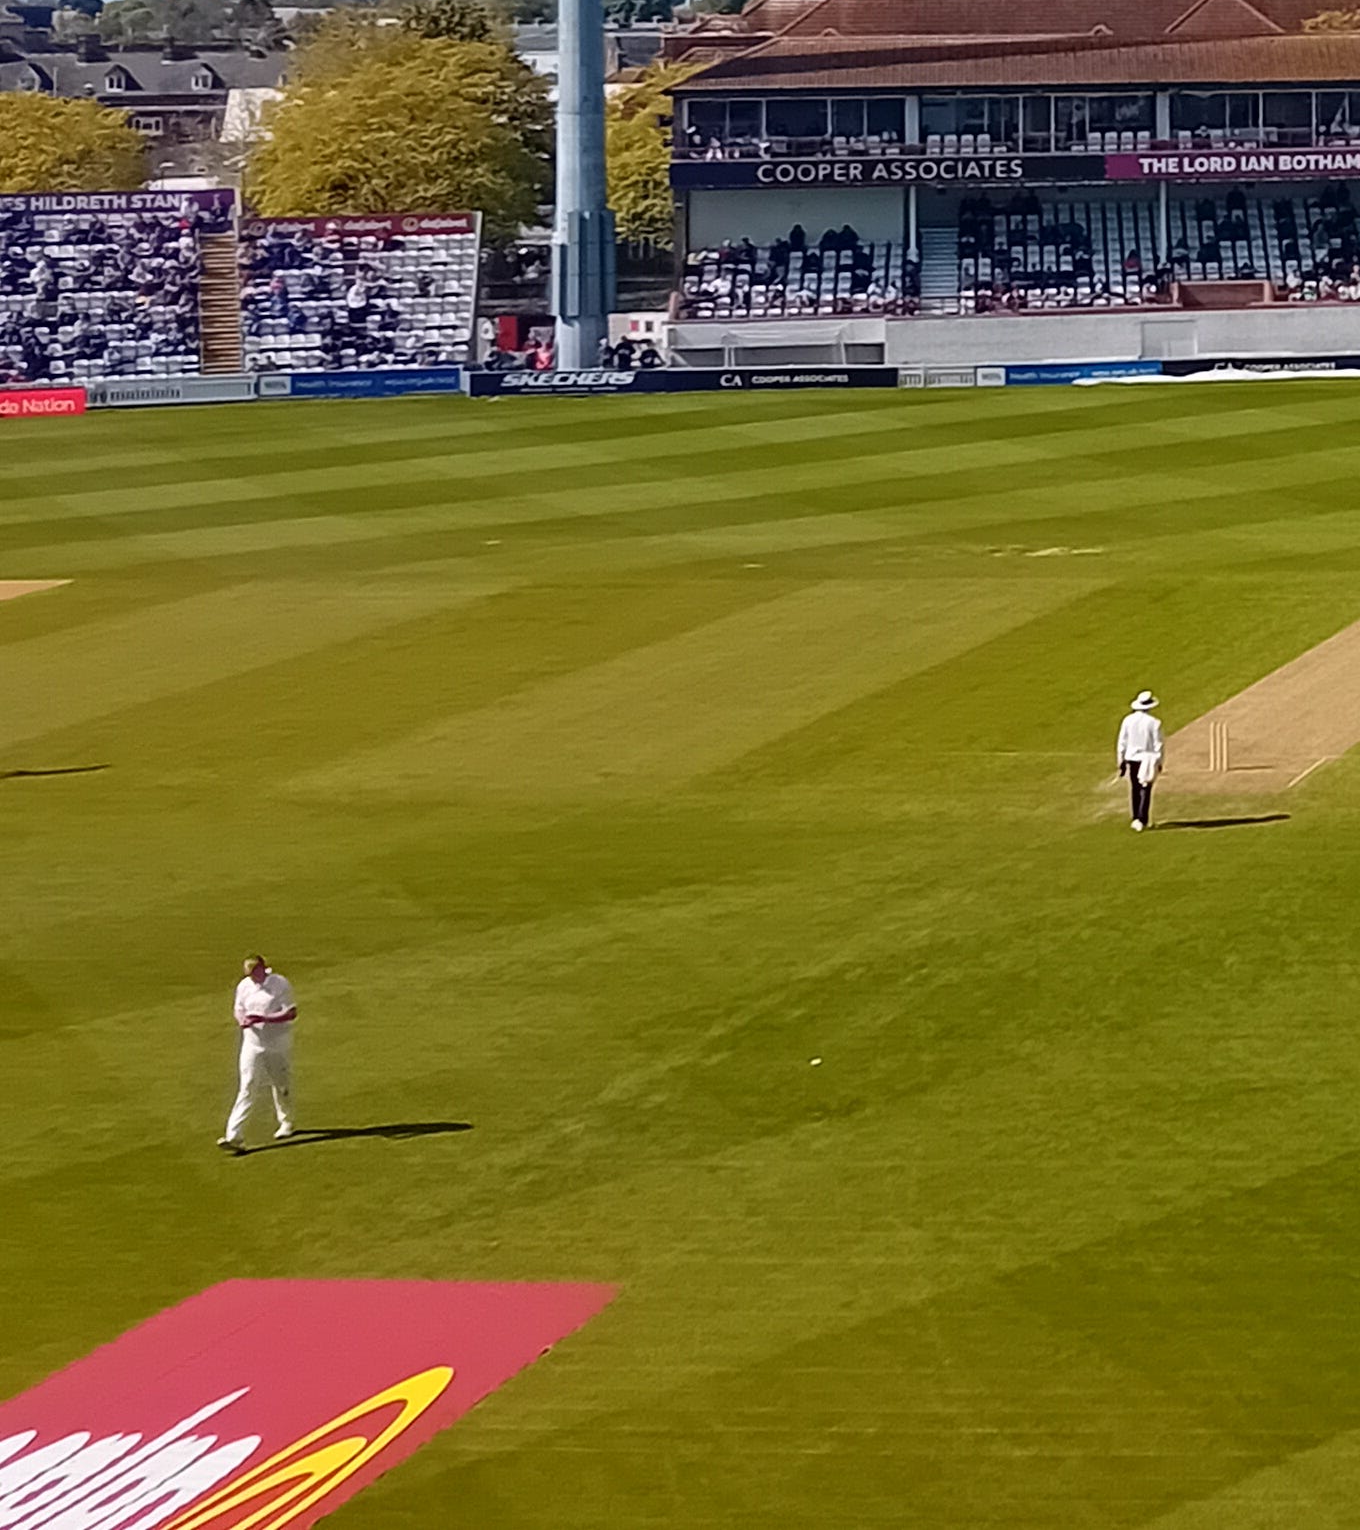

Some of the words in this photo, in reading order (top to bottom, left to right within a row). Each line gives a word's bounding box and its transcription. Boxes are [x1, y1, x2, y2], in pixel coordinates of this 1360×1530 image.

[757, 164, 863, 182] COOPER
[872, 160, 1023, 180] ASSOCIATES
[1139, 157, 1179, 173] THE
[1182, 156, 1236, 172] LORD
[1240, 155, 1274, 171] IAN
[1278, 153, 1360, 170] BOTHAM
[30, 194, 127, 211] HILDRETH
[501, 370, 637, 387] SKECHERS
[720, 374, 742, 387] CA
[751, 375, 791, 384] COOPER
[792, 374, 849, 383] ASSOCIATES
[22, 398, 76, 415] Nation
